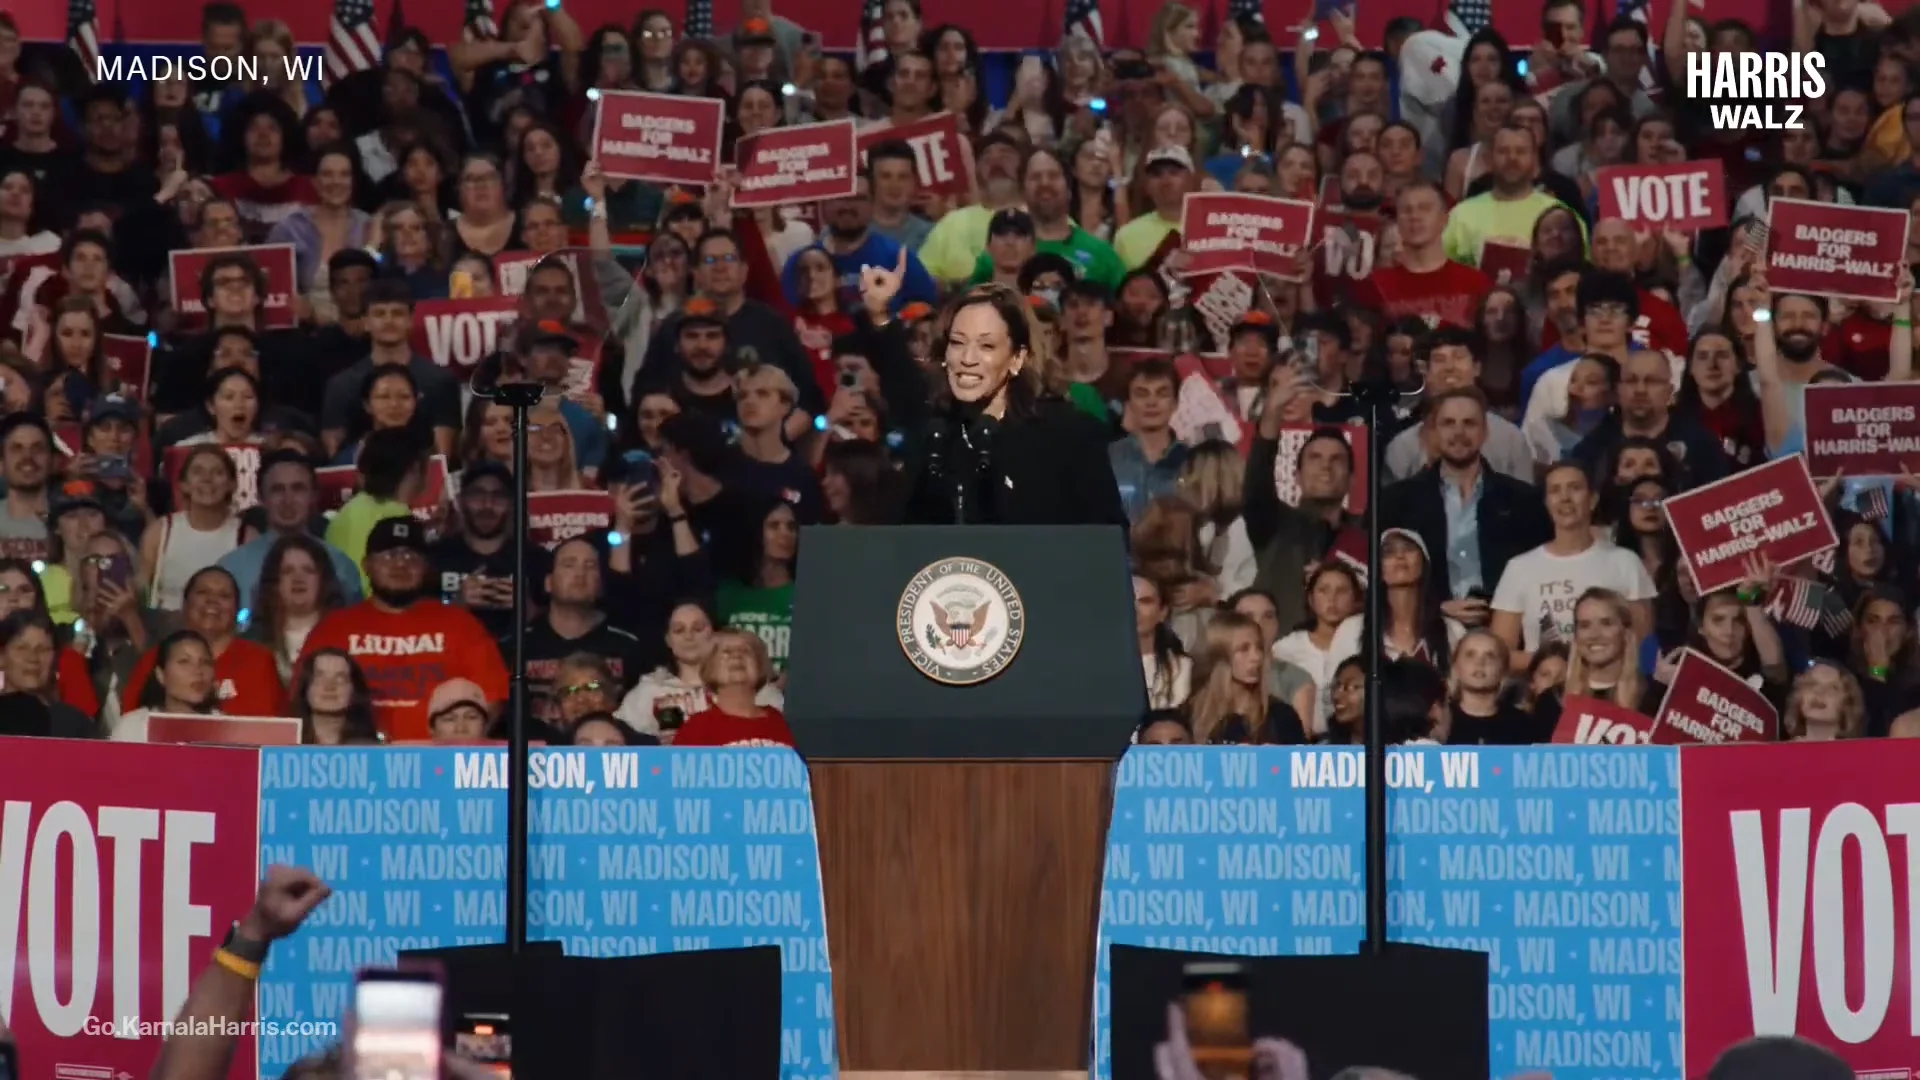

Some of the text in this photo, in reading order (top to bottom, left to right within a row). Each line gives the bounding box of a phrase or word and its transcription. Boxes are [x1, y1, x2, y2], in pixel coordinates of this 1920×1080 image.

[640, 129, 673, 145] FOR
[1612, 170, 1712, 222] VOTE
[1795, 224, 1878, 247] BADGERS
[1817, 243, 1853, 260] FOR
[1831, 406, 1916, 424] BADGERS
[1855, 422, 1892, 438] FOR
[1701, 488, 1784, 531] BADGERS
[1730, 514, 1766, 538] FOR
[900, 562, 1021, 677] VICE PRESIDENT OF THE UNITED STATES
[1696, 687, 1764, 734] BADGERS
[1711, 713, 1743, 740] FOR
[384, 753, 421, 789] WI
[602, 752, 638, 788] WI
[1221, 752, 1257, 787] WI
[1290, 752, 1434, 793] MADION,
[1441, 752, 1479, 788] WI
[1513, 752, 1658, 794] MADISON,
[308, 799, 449, 840] MADISON,
[457, 799, 493, 834] WI
[674, 797, 710, 834] WI
[1144, 798, 1286, 839] MADISON,
[1295, 798, 1331, 833] WI
[1517, 798, 1554, 834] WI
[312, 845, 348, 880] WI
[599, 844, 739, 886] MADISON,
[746, 844, 782, 880] WI
[1148, 844, 1184, 879] WI
[1218, 844, 1361, 886] MADISON,
[1440, 844, 1585, 886] MADISON,
[1592, 845, 1629, 880] WI
[384, 890, 420, 926] WI
[602, 890, 637, 926] WI
[671, 890, 811, 932] MADISON,
[1221, 890, 1258, 926] WI
[1442, 890, 1479, 927] WI
[1514, 891, 1660, 932] MADISON,
[1517, 937, 1555, 974] WI
[1592, 985, 1631, 1021] WI
[1516, 1031, 1661, 1073] MADISON,
